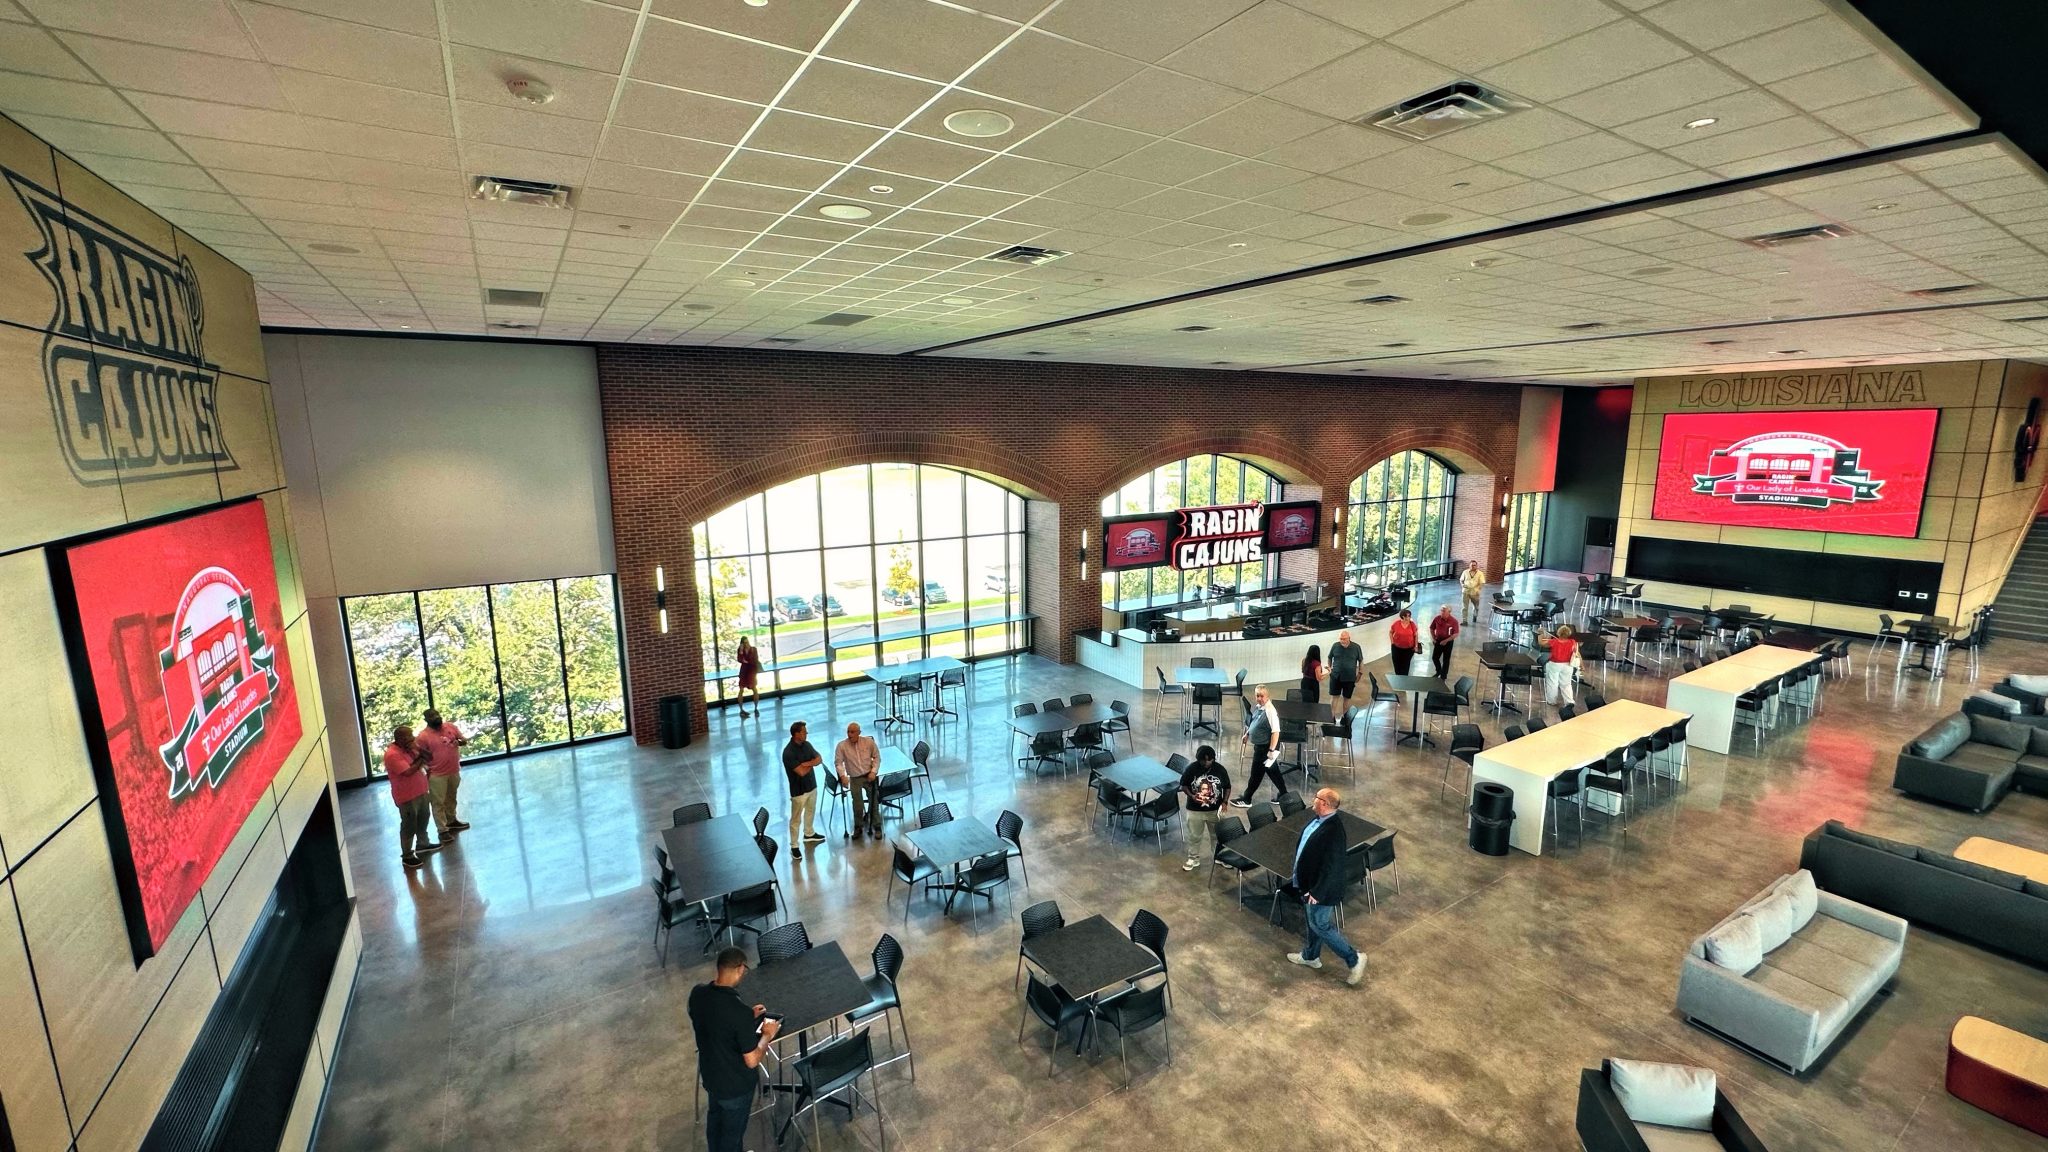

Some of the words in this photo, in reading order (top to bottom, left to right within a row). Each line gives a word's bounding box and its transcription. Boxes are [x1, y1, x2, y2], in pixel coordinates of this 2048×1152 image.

[55, 356, 224, 460] CAJUNS
[1678, 369, 1927, 408] LOUISIANA
[1763, 484, 1783, 494] Lady
[1794, 486, 1828, 494] Lourdes
[1180, 536, 1264, 569] CAJUNS
[180, 576, 210, 616] INAUGURAL
[211, 725, 222, 741] Our
[222, 710, 236, 732] Lady
[239, 688, 258, 712] Lourdes
[224, 723, 249, 758] STADIUM
